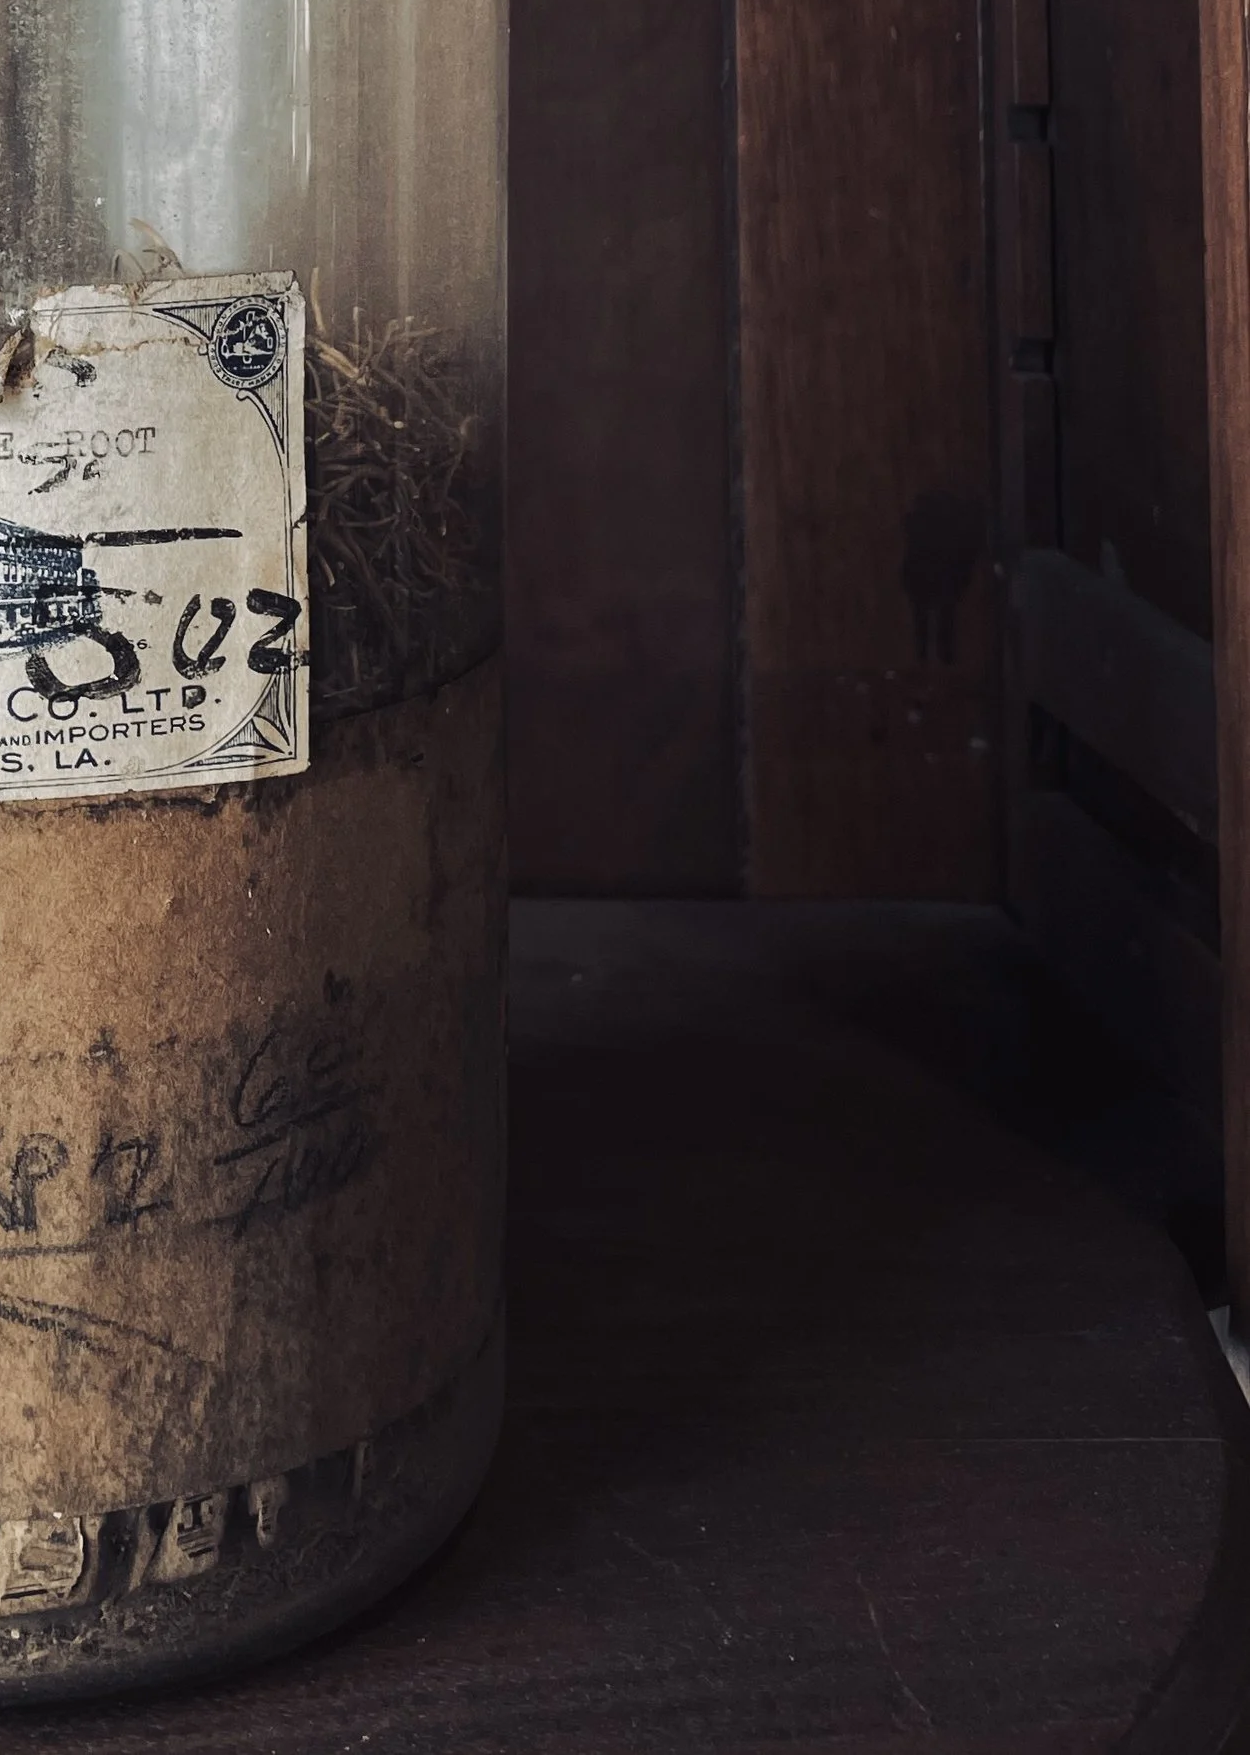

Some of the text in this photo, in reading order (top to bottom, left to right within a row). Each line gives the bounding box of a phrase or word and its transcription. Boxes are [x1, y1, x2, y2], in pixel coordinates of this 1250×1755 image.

[62, 426, 156, 459] ROOT
[7, 685, 98, 722] CO.
[121, 684, 223, 715] LTD.
[35, 714, 206, 746] IMPORTERS
[54, 747, 113, 770] LA.
